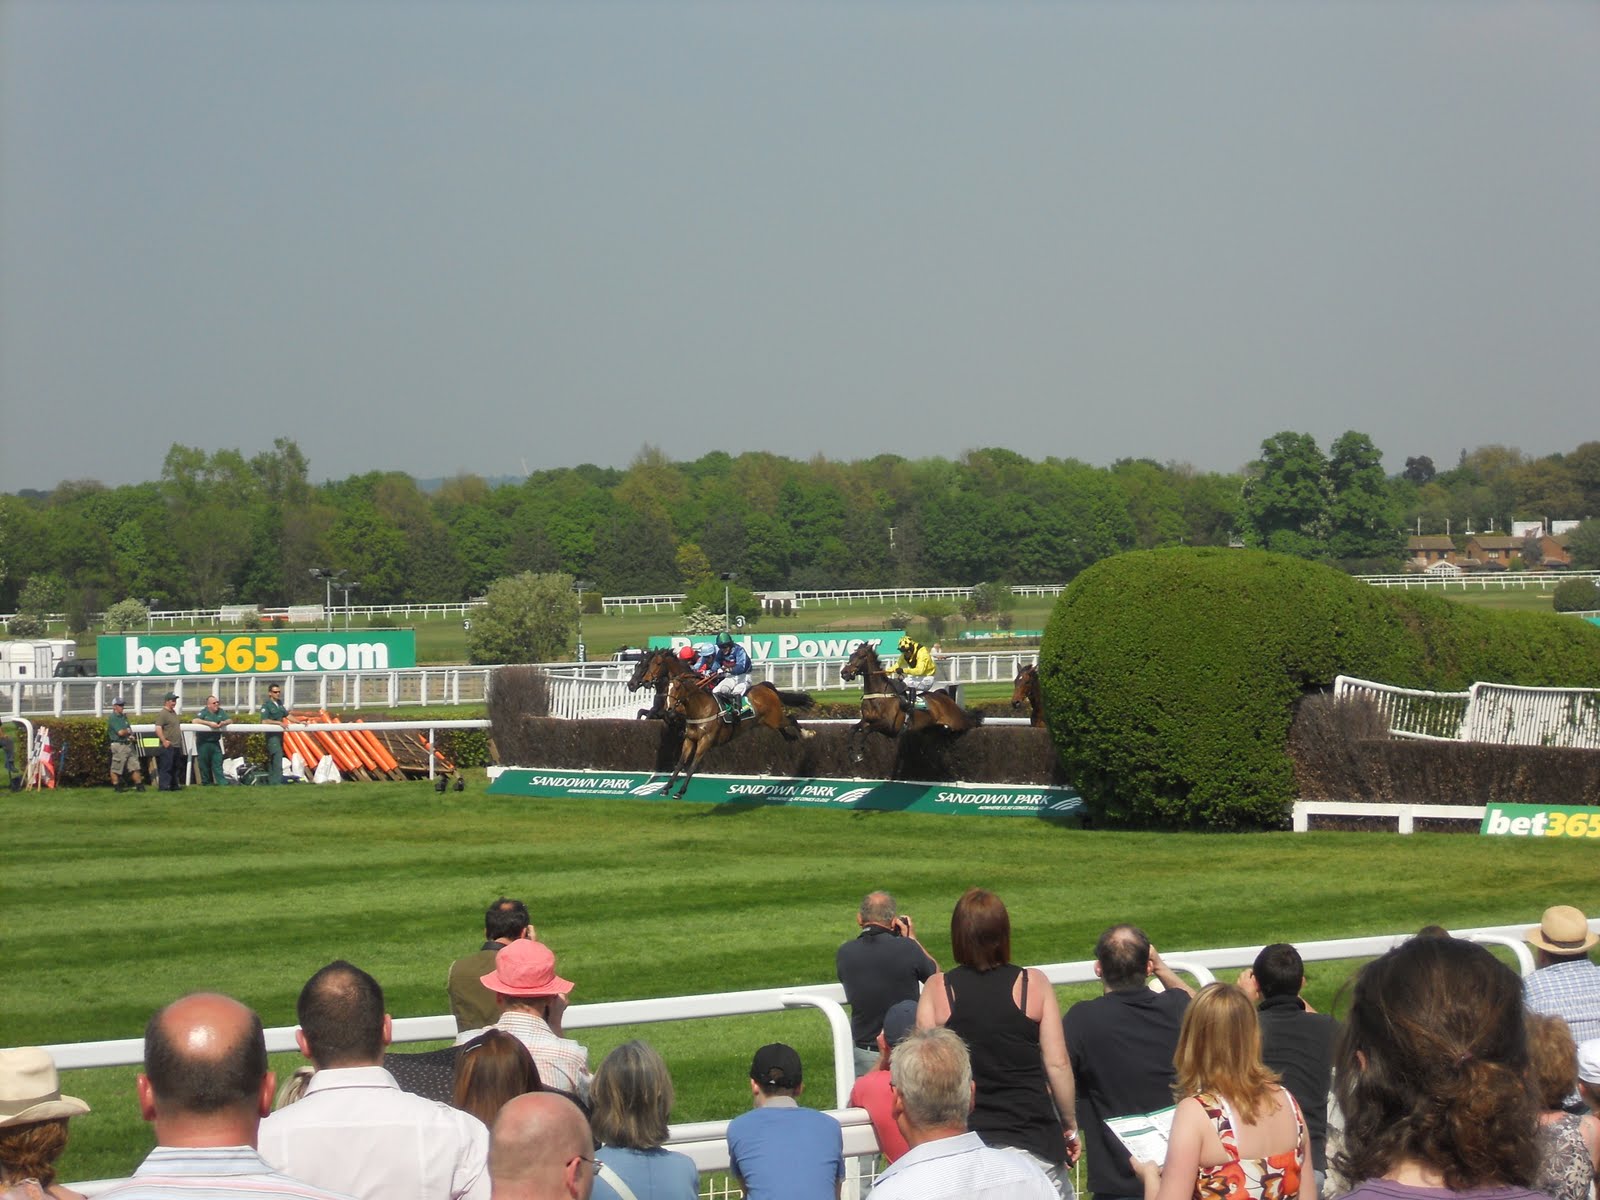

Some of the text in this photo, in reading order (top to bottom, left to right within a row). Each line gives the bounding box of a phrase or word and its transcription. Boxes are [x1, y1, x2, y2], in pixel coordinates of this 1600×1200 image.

[125, 636, 389, 674] bet365.com
[671, 635, 773, 663] Pdy
[528, 775, 634, 789] SANDOWN PARK
[726, 784, 838, 797] SANDOWN PARK
[935, 792, 1053, 805] SANDOWN PARK
[1486, 809, 1600, 838] bet365
